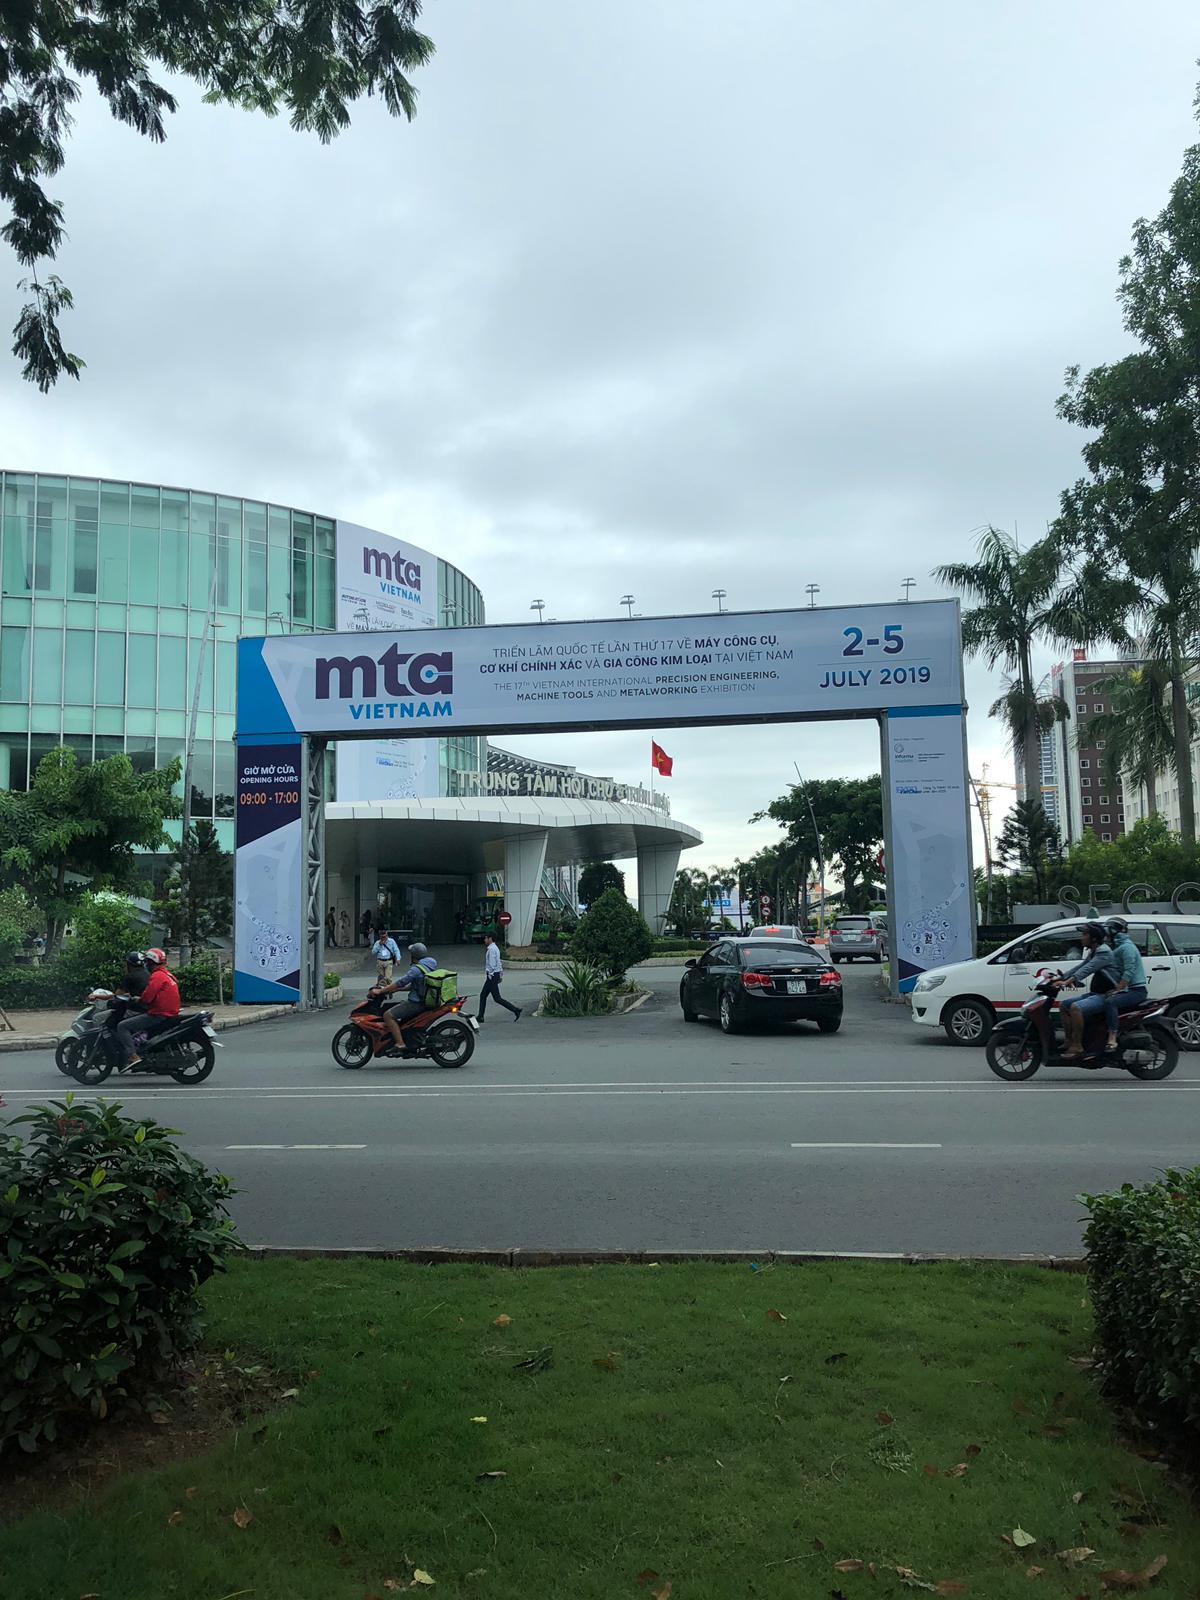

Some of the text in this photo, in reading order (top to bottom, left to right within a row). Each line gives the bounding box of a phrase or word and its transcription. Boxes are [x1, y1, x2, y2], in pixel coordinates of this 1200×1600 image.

[363, 546, 421, 591] mta
[380, 581, 422, 605] VIETNAM
[493, 643, 526, 658] TRIỂN
[529, 645, 553, 657] LÃM
[556, 642, 588, 656] QUỐC
[591, 640, 605, 654] TẾ
[608, 640, 630, 653] LẦN
[633, 639, 658, 652] THỨ
[661, 640, 673, 650] 17
[677, 637, 691, 650] VỀ
[694, 636, 721, 649] MÁY
[724, 635, 757, 647] CÔNG
[842, 624, 904, 657] 2-5
[315, 642, 453, 700] mta
[480, 650, 794, 674] CƠ KHÍ CHÍNH XÁC VÀ GIA CÔNG KIM LOẠI TẠI VIỆT NAM
[493, 682, 512, 691] THE
[532, 679, 575, 690] VIETNAM
[576, 676, 653, 688] INTERNATIONAL
[655, 673, 707, 684] PRECISION
[710, 670, 780, 682] ENGINEERING,
[819, 666, 931, 688] JULY 2019
[516, 683, 756, 701] MACHINE TOOLS AND METALWORKING EXHIBITION
[349, 701, 453, 720] VIETNAM
[240, 775, 299, 784] OPENING HOURS
[243, 763, 296, 775] GIỜ MỞ CỬA
[456, 771, 520, 791] TRUNG
[524, 769, 557, 793] TÂM
[240, 792, 267, 805] 09:00
[274, 791, 299, 804] 17:00
